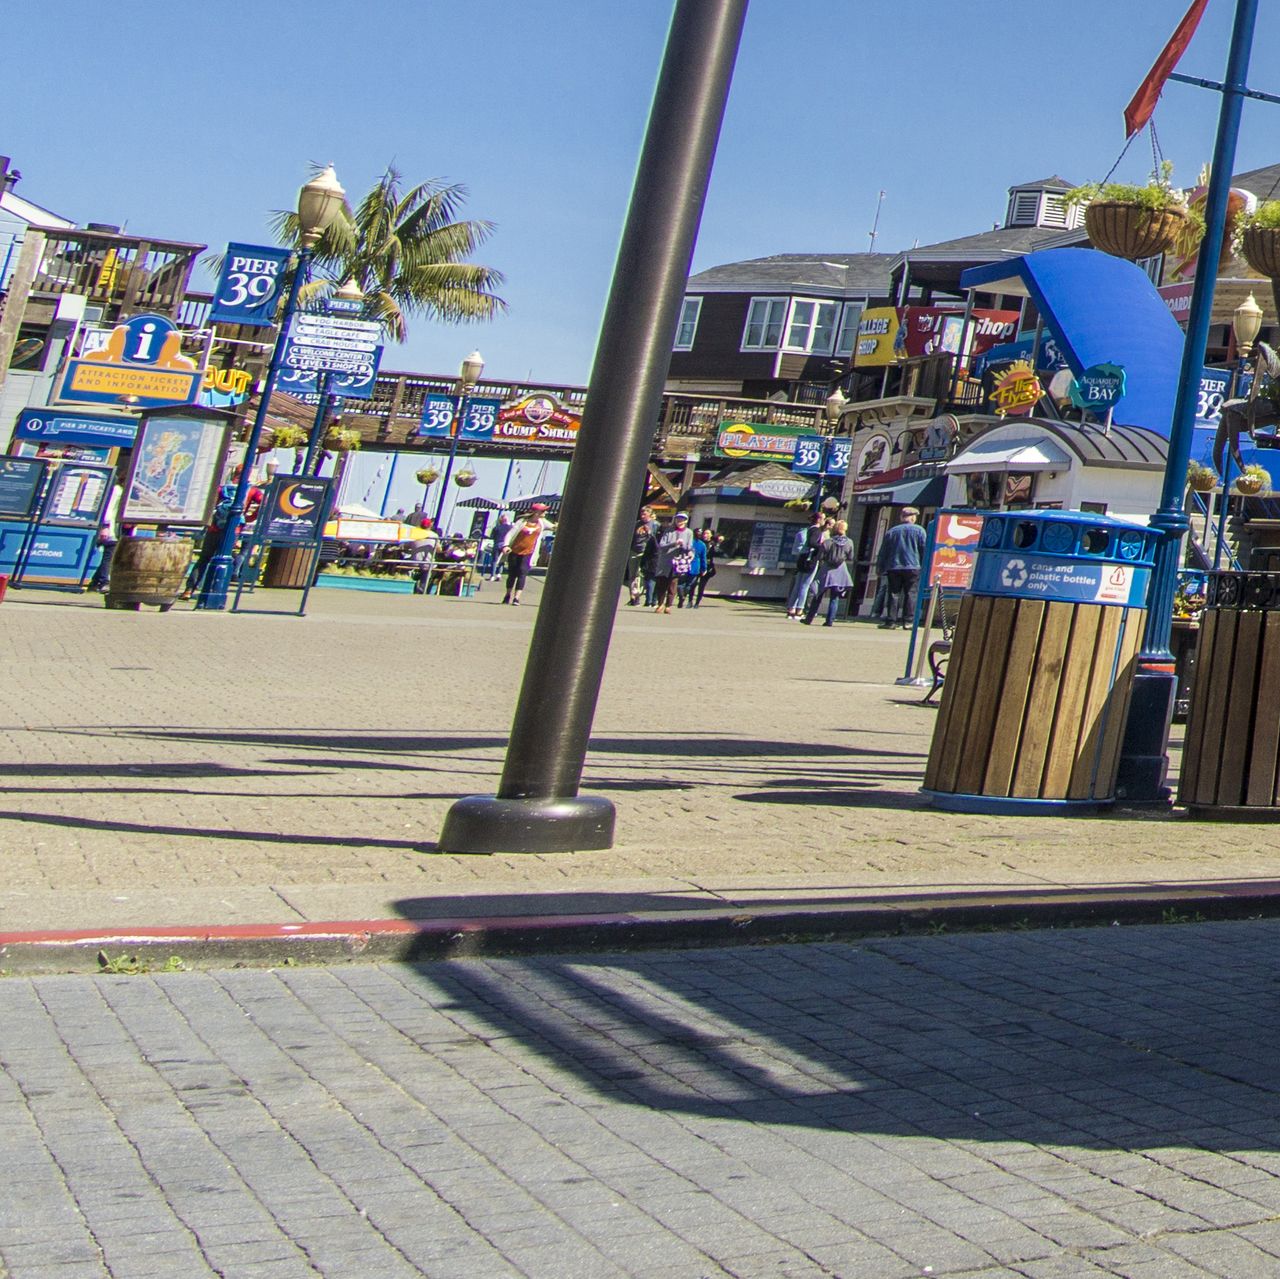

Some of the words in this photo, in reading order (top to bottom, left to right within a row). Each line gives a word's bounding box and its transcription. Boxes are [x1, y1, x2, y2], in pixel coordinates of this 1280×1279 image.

[230, 256, 279, 275] PIER
[219, 273, 276, 308] 39
[328, 300, 350, 309] PIER
[300, 348, 334, 357] WELCOME
[336, 350, 362, 359] CENTER
[300, 359, 324, 368] LEVEL
[332, 361, 358, 371] SHOPS
[79, 369, 146, 381] ATTRACTION
[149, 375, 189, 386] TICKETS
[1081, 376, 1119, 386] AQUARIUM
[77, 377, 101, 386] AND
[106, 379, 188, 394] INFORMATION
[1088, 386, 1117, 401] BAY
[428, 401, 454, 411] PIER
[471, 404, 496, 415] PIER
[1195, 391, 1225, 419] 39
[424, 410, 453, 429] 39
[465, 413, 495, 432] 39
[503, 421, 537, 436] GUMP
[538, 424, 578, 439] SHRIM
[799, 441, 820, 450] PIER
[795, 449, 820, 466] 39
[1031, 563, 1053, 571] cans
[1055, 565, 1074, 573] and
[1029, 572, 1061, 582] plastic
[1063, 575, 1096, 585] bottles
[1027, 582, 1048, 591] only
